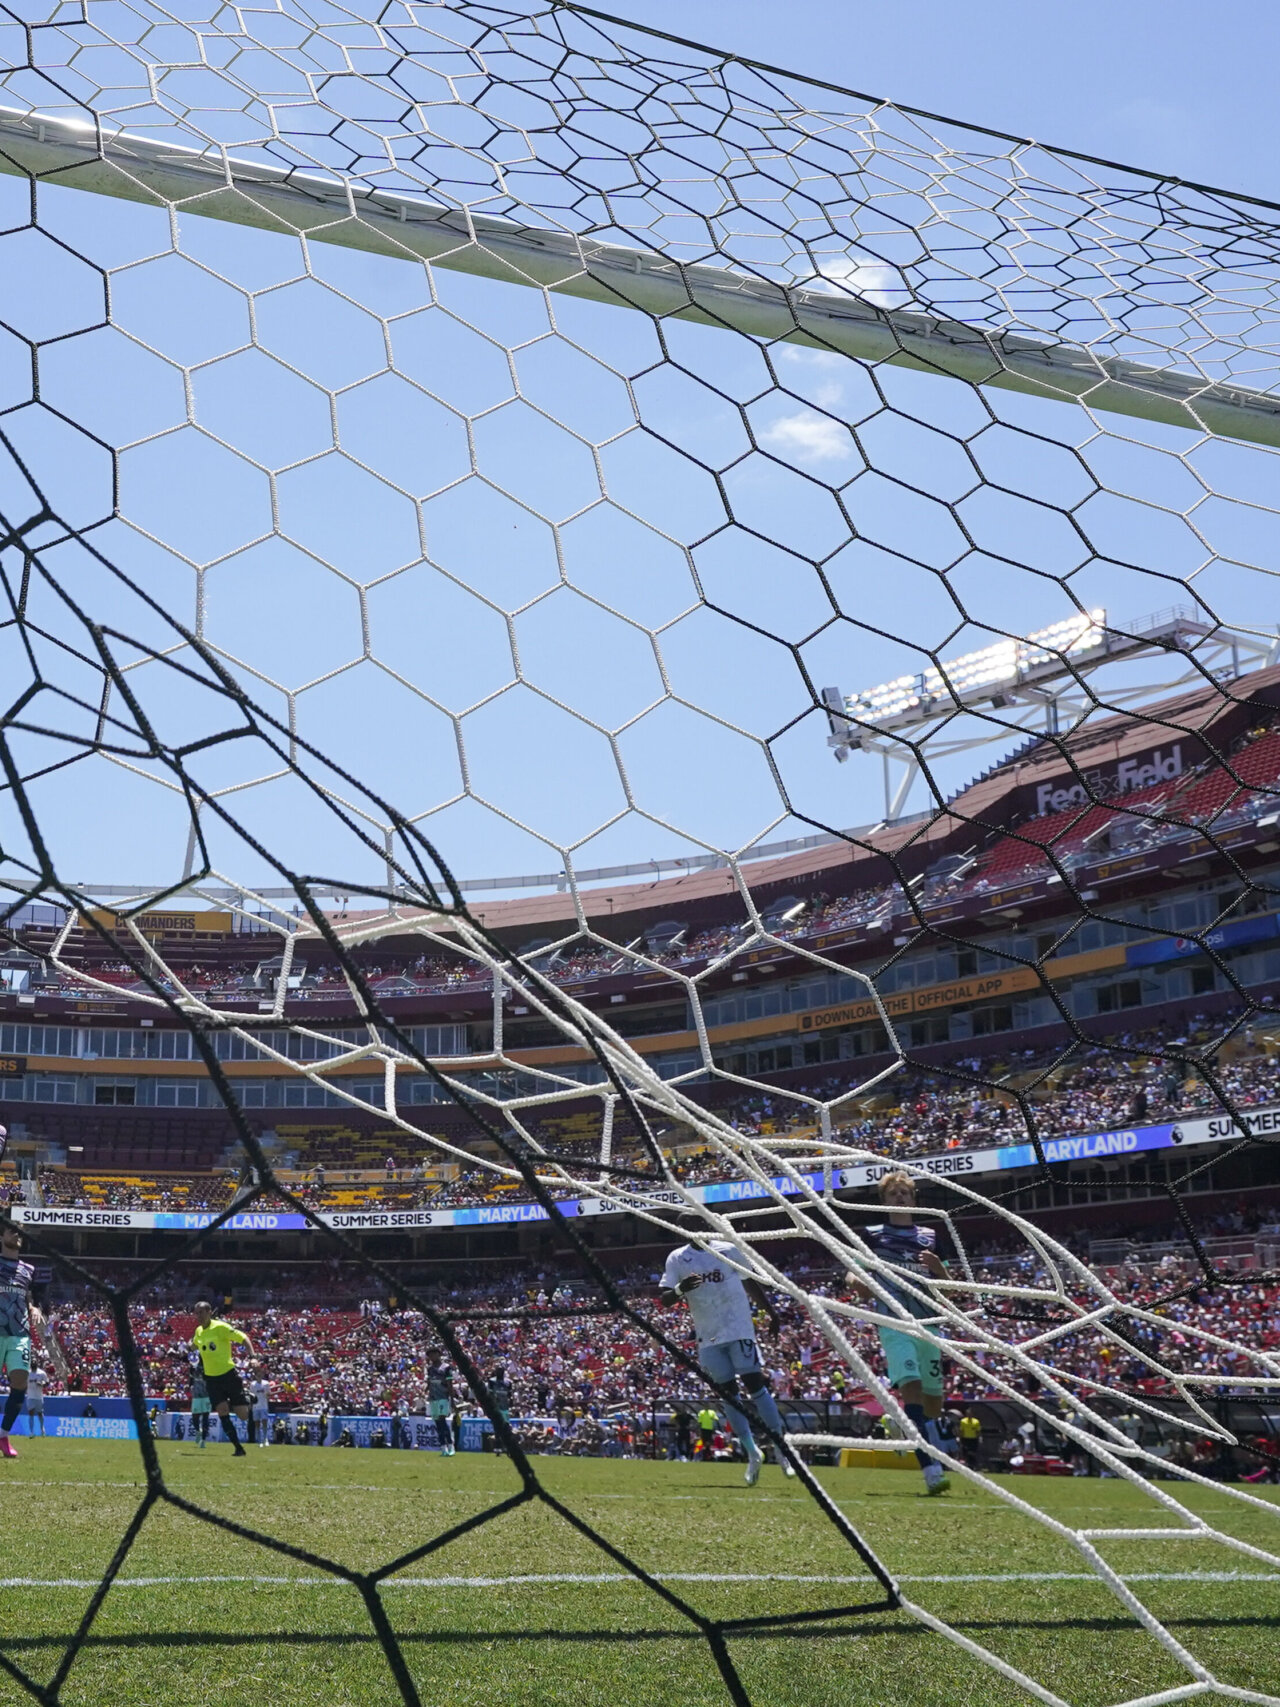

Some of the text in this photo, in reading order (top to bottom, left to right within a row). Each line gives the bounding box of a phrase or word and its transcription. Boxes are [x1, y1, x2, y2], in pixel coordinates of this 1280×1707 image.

[1190, 931, 1224, 950] ppsi
[918, 986, 973, 1007] OFFICIAL
[976, 980, 1003, 995] APP
[23, 1210, 131, 1225] SUMMER SERIES
[332, 1213, 432, 1227] SUMMER SERIES
[479, 1204, 552, 1223] MARYLAN
[58, 1417, 129, 1429] THE SEASON
[56, 1427, 129, 1438] STARTS HERE
